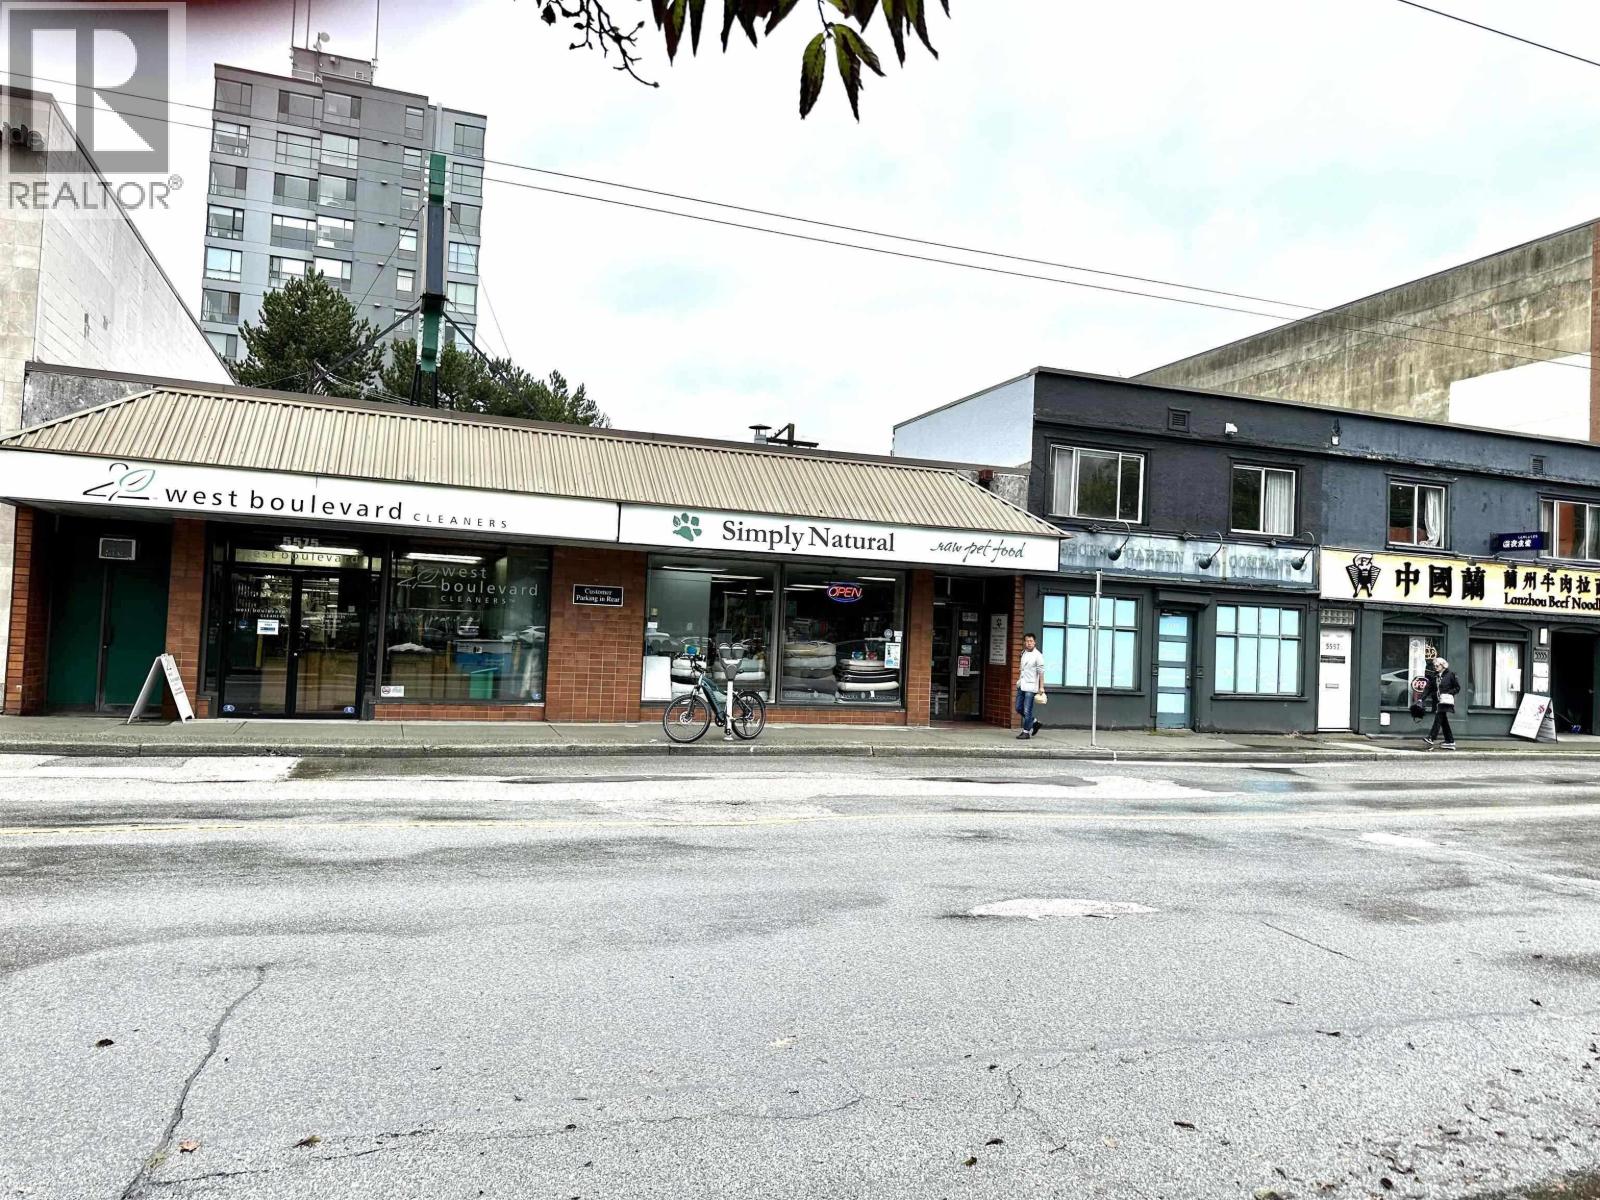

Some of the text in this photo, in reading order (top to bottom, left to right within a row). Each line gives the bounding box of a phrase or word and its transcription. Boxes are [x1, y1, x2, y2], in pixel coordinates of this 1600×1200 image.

[165, 488, 508, 529] west boulevard CLEANERS
[962, 539, 992, 563] pet
[990, 539, 1027, 563] food
[442, 567, 487, 579] west
[440, 578, 539, 597] boulevard
[1395, 562, 1486, 601] 中國蘭
[576, 594, 599, 603] Parking
[584, 587, 613, 596] Customer
[828, 586, 863, 598] OPEN
[1504, 592, 1547, 608] Lanzhou
[1548, 595, 1571, 608] Beef
